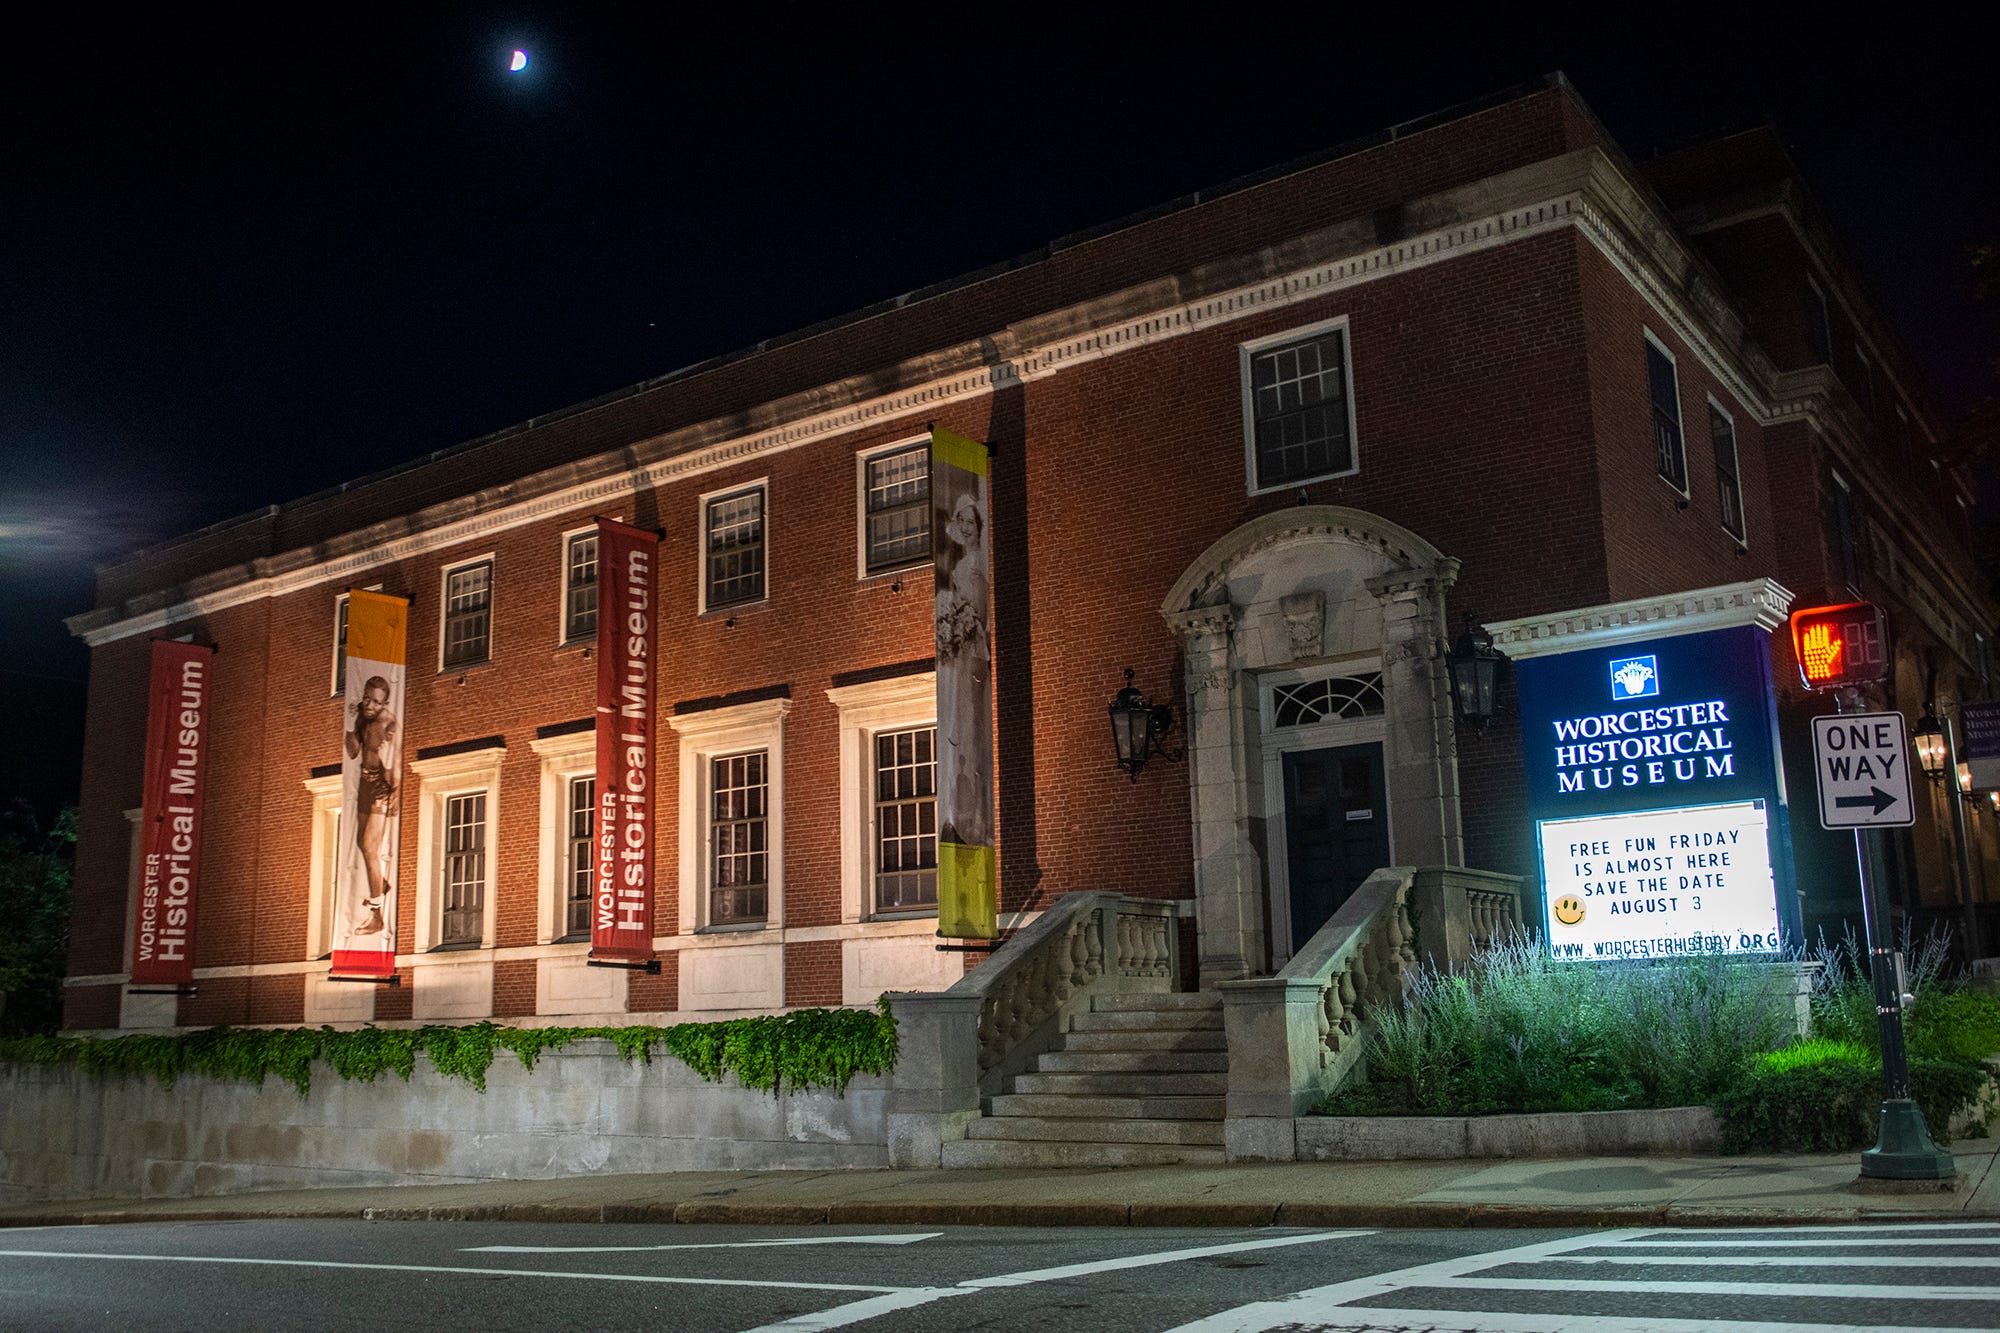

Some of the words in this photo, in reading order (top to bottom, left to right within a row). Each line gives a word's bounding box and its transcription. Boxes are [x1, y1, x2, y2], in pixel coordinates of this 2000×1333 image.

[621, 549, 649, 720] Museum
[170, 660, 204, 795] Museum
[1552, 700, 1729, 743] WORCESTER
[1826, 723, 1894, 752] ONE
[1555, 727, 1733, 768] HISTORICAL
[1827, 753, 1897, 782] WAY
[1557, 754, 1735, 794] MUSEUM
[618, 733, 647, 931] Historical
[1569, 840, 1611, 858] FREE
[1625, 837, 1656, 853] FUN
[1669, 829, 1740, 850] FRIDAY
[598, 792, 616, 931] WORCESTER
[1574, 862, 1593, 877] IS
[1605, 856, 1674, 875] ALMOST
[1686, 851, 1732, 869] HERE
[158, 806, 194, 961] Historical
[1583, 880, 1628, 897] SAVE
[1636, 876, 1668, 893] THE
[1679, 873, 1726, 891] DATE
[139, 853, 160, 961] WORCESTER
[1610, 897, 1679, 916] AUGUST
[1692, 895, 1702, 911] 3
